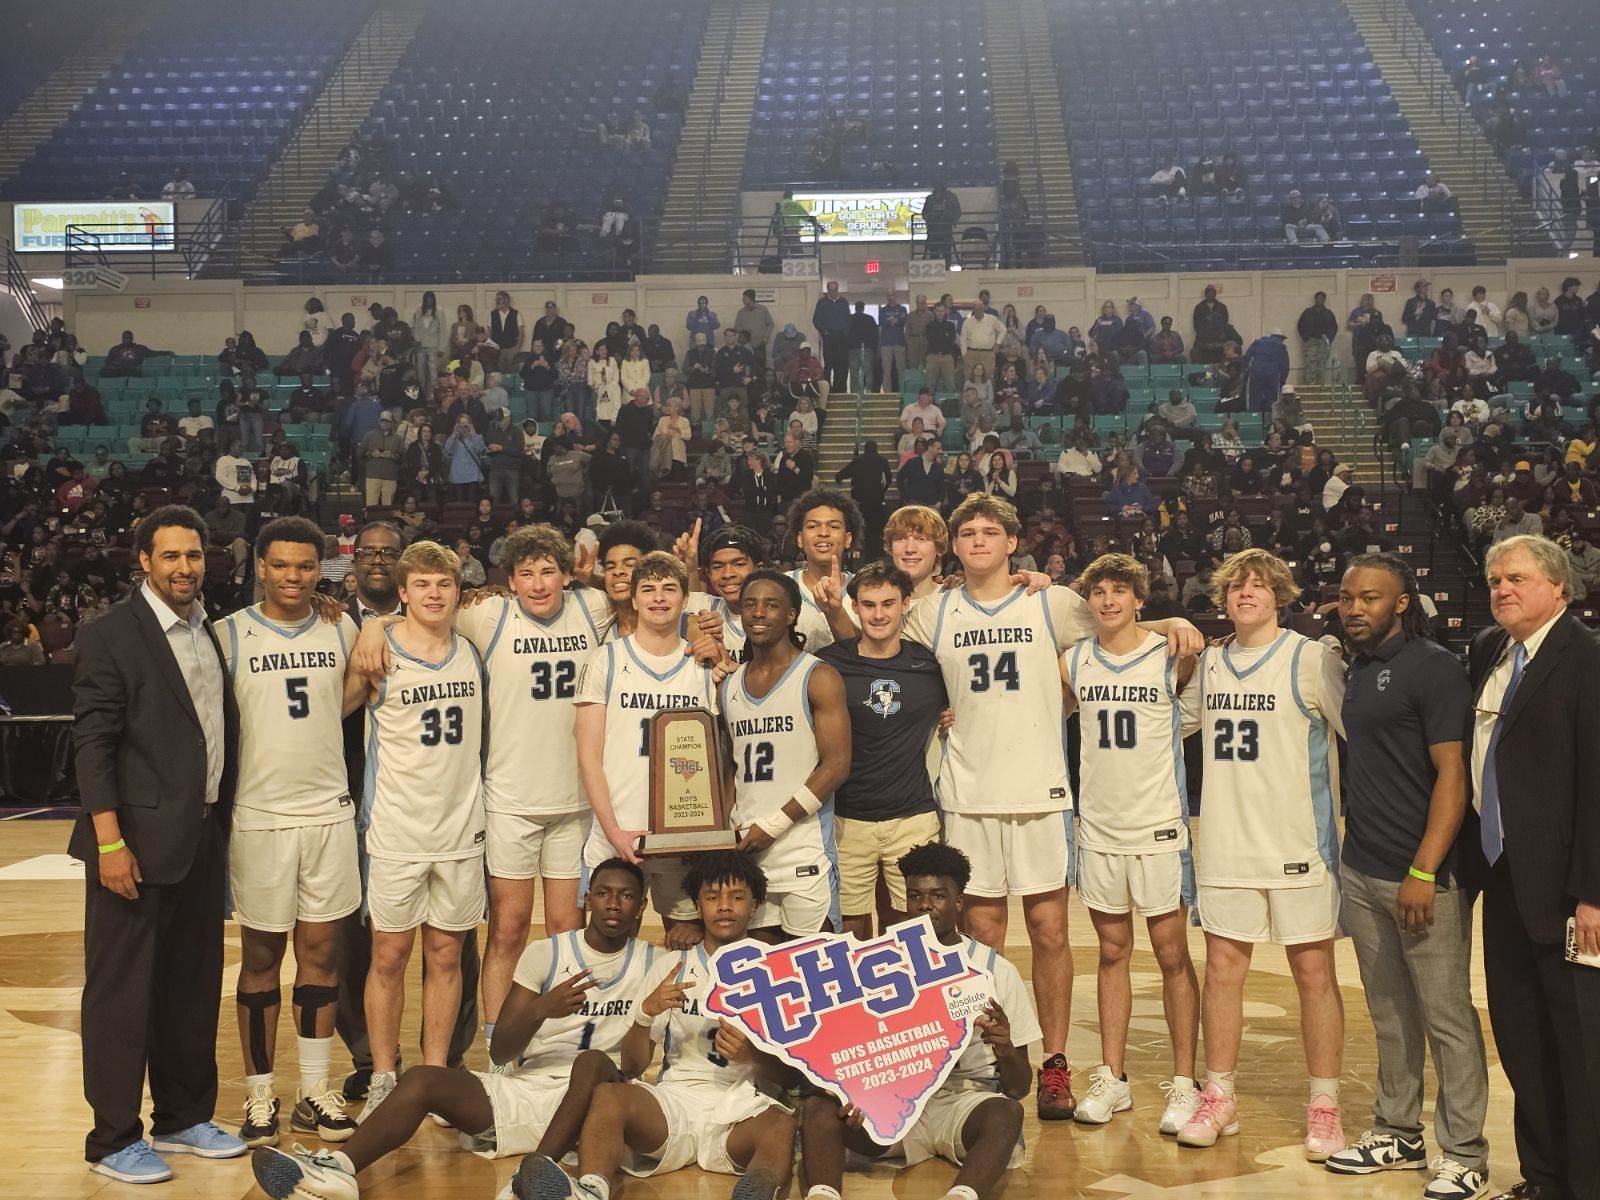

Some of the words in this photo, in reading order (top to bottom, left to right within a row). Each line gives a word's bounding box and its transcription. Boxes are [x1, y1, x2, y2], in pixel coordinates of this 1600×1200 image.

[809, 198, 927, 216] JIMMY'S
[23, 208, 137, 233] Parrott's
[847, 221, 888, 230] SERVICE
[63, 270, 97, 285] 320
[784, 261, 817, 277] 321
[866, 263, 879, 273] EXIT
[910, 261, 945, 277] 322
[513, 634, 588, 654] CAVALIERS
[954, 627, 1033, 648] CAVALIERS
[249, 651, 336, 674] CAVALIERS
[968, 650, 1021, 693] 34
[530, 659, 576, 701] 32
[285, 676, 311, 720] 5
[401, 681, 476, 706] CAVALIERS
[620, 692, 699, 710] CAVALIERS
[1080, 685, 1158, 703] CAVALIERS
[1206, 693, 1276, 712] CAVALIERS
[420, 705, 464, 747] 33
[1097, 709, 1137, 749] 10
[669, 743, 702, 751] CHAMPION
[1213, 717, 1260, 763] 23
[743, 741, 776, 783] 12
[668, 803, 709, 811] BASKETBALL
[714, 923, 966, 1045] SCHSL
[949, 991, 986, 1010] absolute
[951, 1006, 972, 1019] total
[973, 1000, 992, 1012] care
[577, 1022, 595, 1050] 1
[878, 1020, 889, 1034] A
[831, 1044, 867, 1066] BOYS
[866, 1020, 945, 1054] BASKETBALL
[835, 1058, 874, 1081] STATE
[873, 1035, 950, 1069] CHAMPIONS
[861, 1057, 933, 1090] 2023-2024
